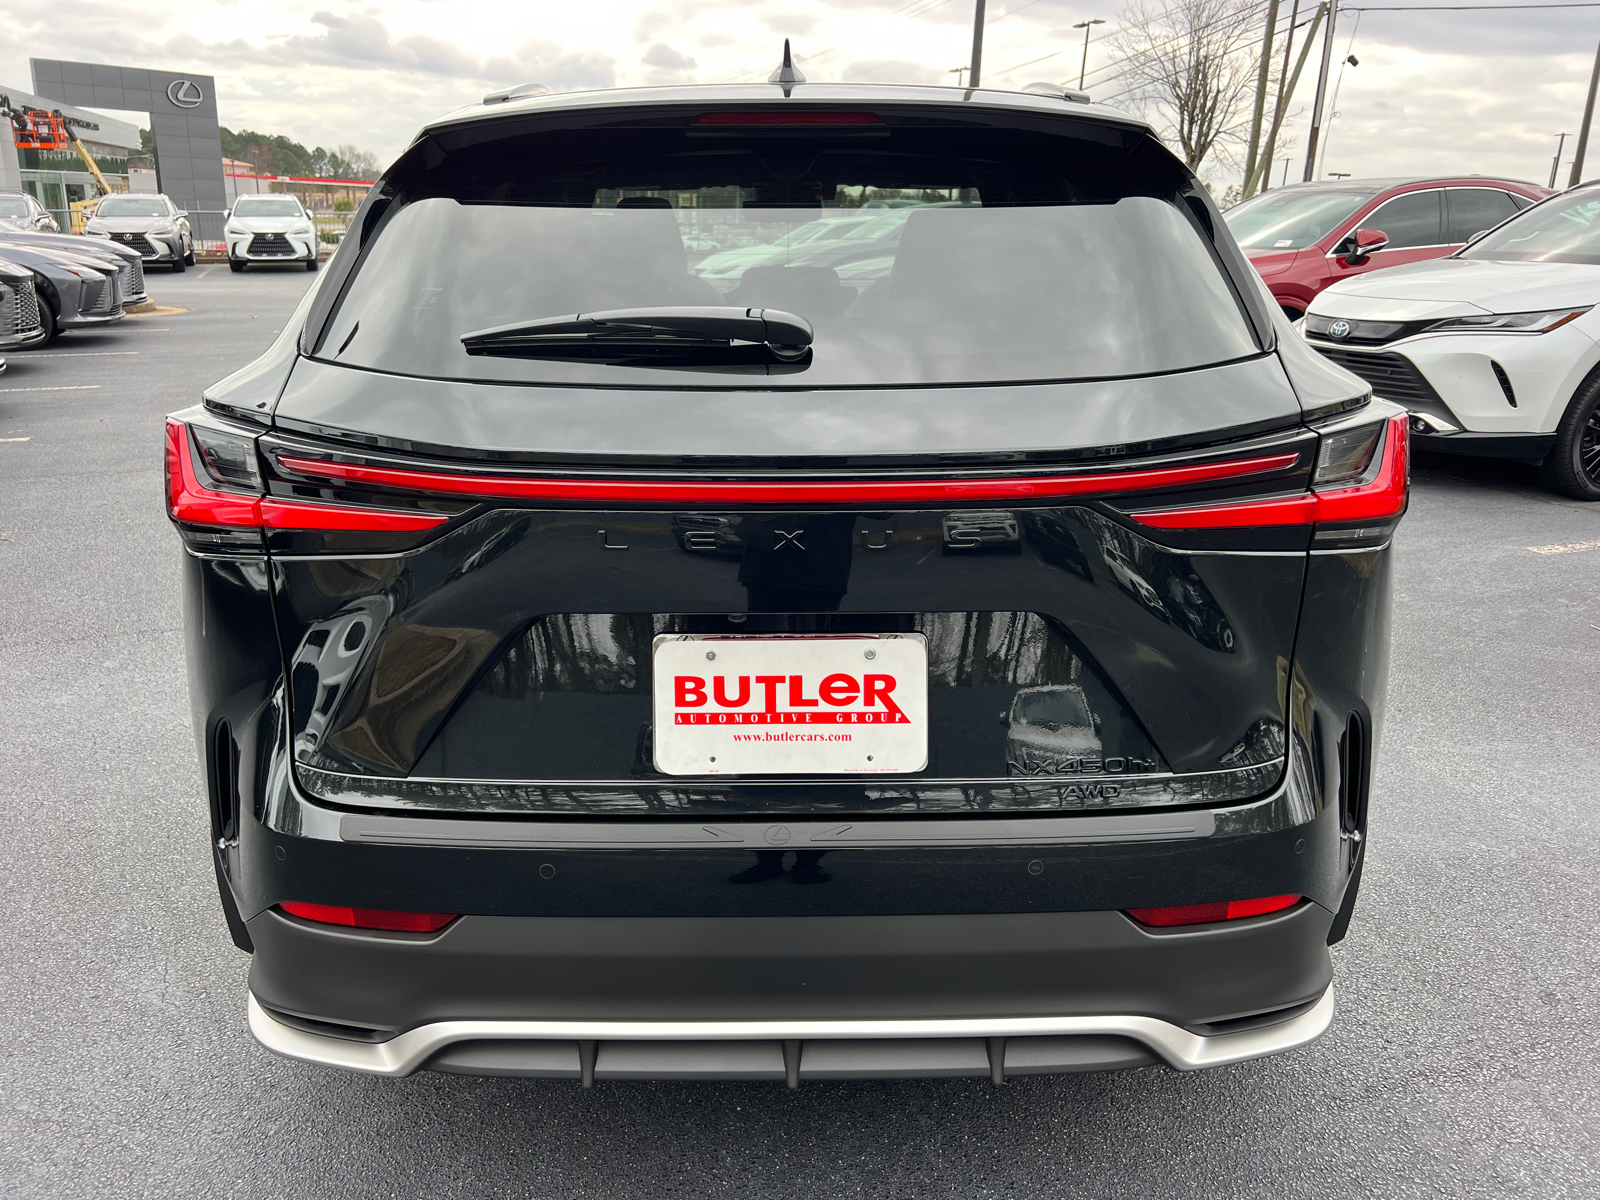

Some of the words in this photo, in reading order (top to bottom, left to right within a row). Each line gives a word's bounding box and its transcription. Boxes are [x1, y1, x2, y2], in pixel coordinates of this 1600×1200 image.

[597, 529, 983, 551] LEXUS
[675, 713, 812, 724] AUTOMOTIVE
[835, 712, 902, 723] GROUP
[733, 732, 852, 743] www.butlercars.com
[1061, 784, 1121, 799] AWD
